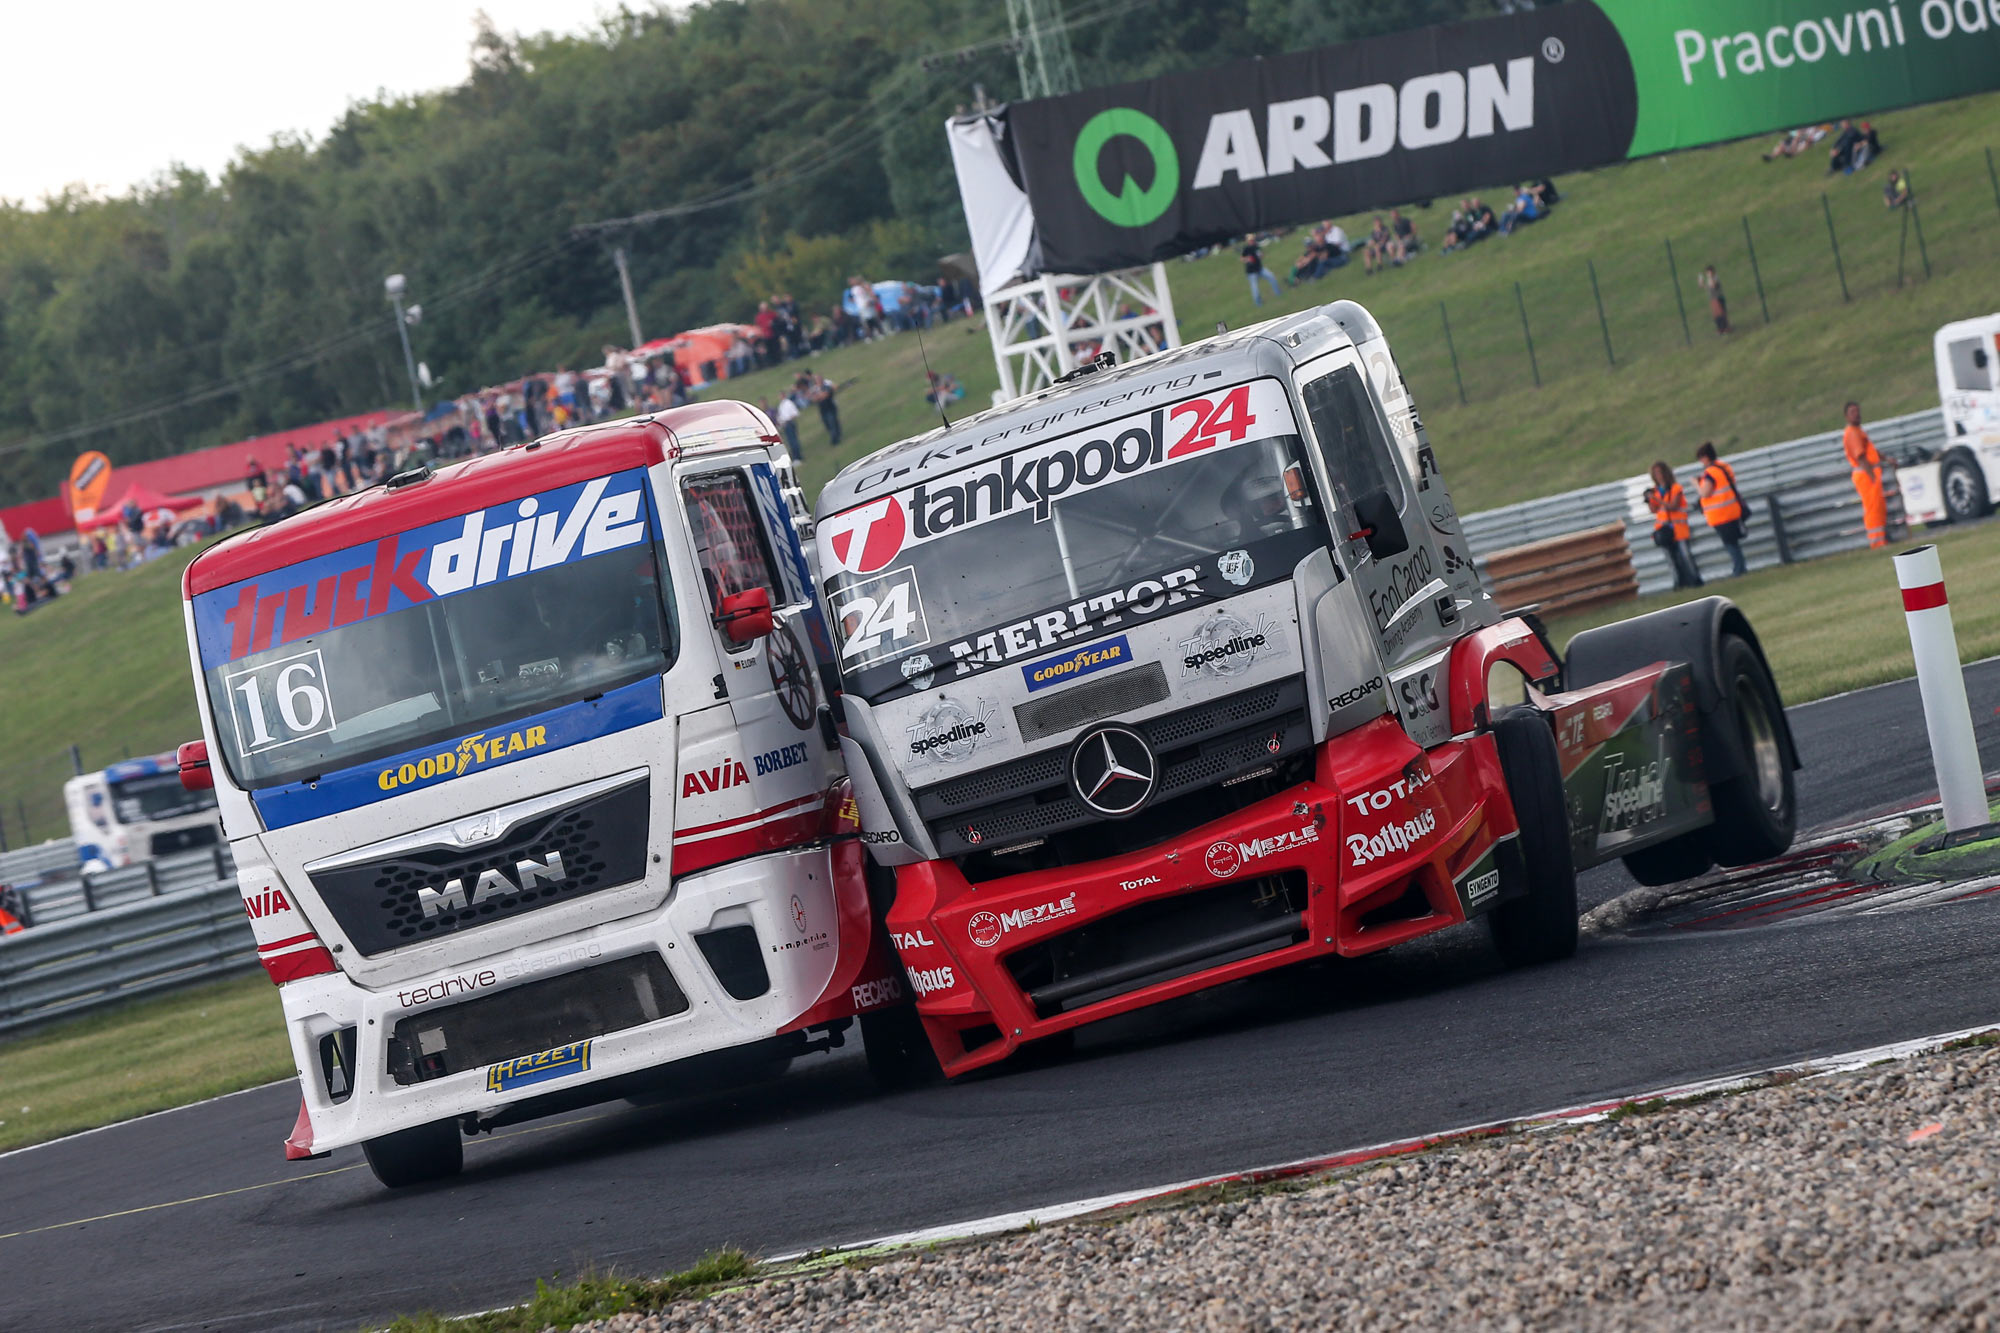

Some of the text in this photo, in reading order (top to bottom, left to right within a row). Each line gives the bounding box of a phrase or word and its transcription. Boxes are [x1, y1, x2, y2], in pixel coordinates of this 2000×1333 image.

[1193, 57, 1535, 190] ARDON
[225, 476, 645, 661] truckdrive
[1369, 545, 1432, 635] EcoCargo
[840, 581, 916, 659] 24
[949, 568, 1205, 676] MERITOR
[1033, 645, 1121, 682] GOODYEAR
[1184, 633, 1266, 671] speedline
[236, 663, 326, 748] 16
[1328, 676, 1383, 711] RECARO
[378, 725, 547, 791] GOODYEAR
[753, 741, 808, 777] BORBET
[911, 721, 986, 757] speedline
[1347, 767, 1431, 816] TOTAL
[1346, 808, 1436, 867] Rothaus
[417, 850, 567, 919] MAN
[1120, 875, 1161, 891] TOTAL
[397, 970, 496, 1008] tedrive
[852, 975, 902, 1009] RECARO
[498, 1044, 582, 1080] HAZET
